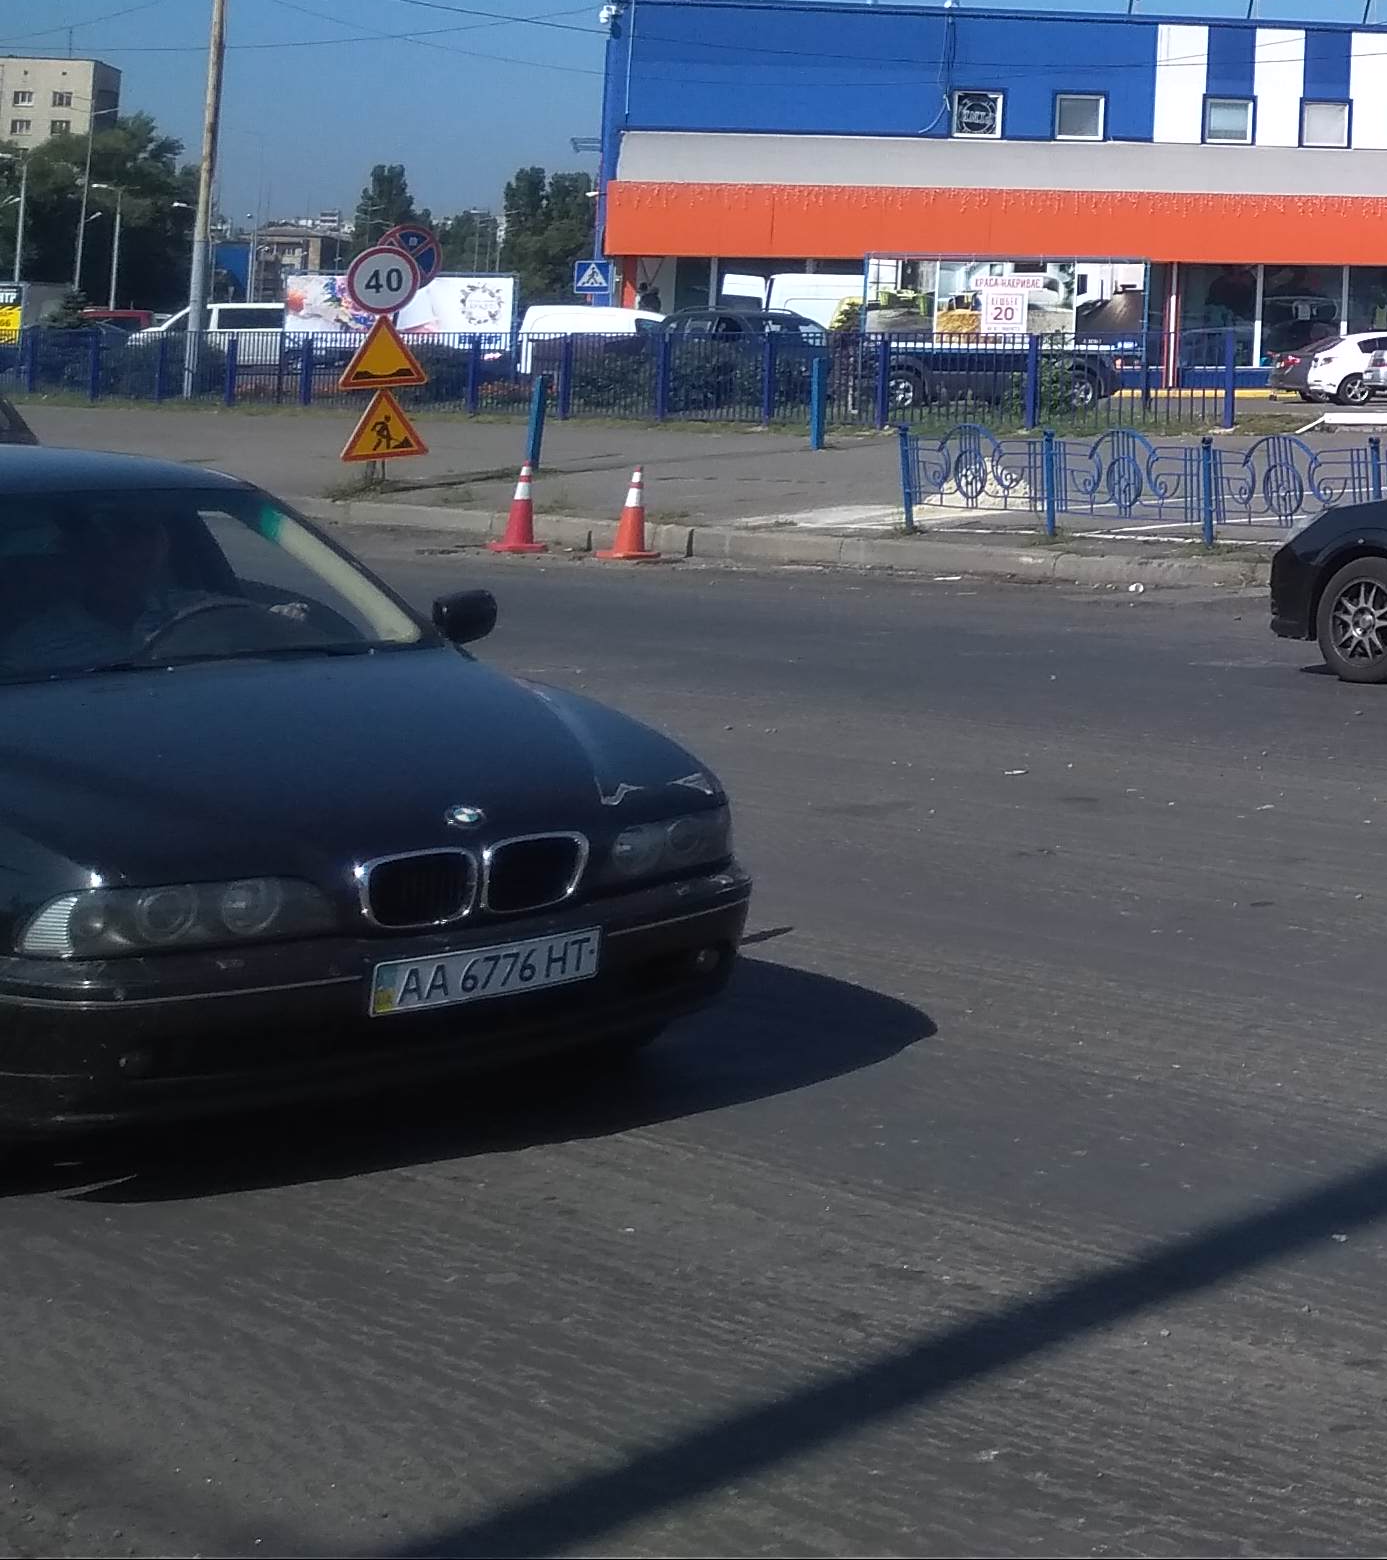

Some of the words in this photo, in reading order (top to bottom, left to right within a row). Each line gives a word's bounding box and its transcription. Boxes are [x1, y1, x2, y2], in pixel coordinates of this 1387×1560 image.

[365, 268, 403, 293] 40
[397, 964, 449, 1004] AA
[460, 948, 537, 993] 6776
[545, 936, 592, 977] HT
